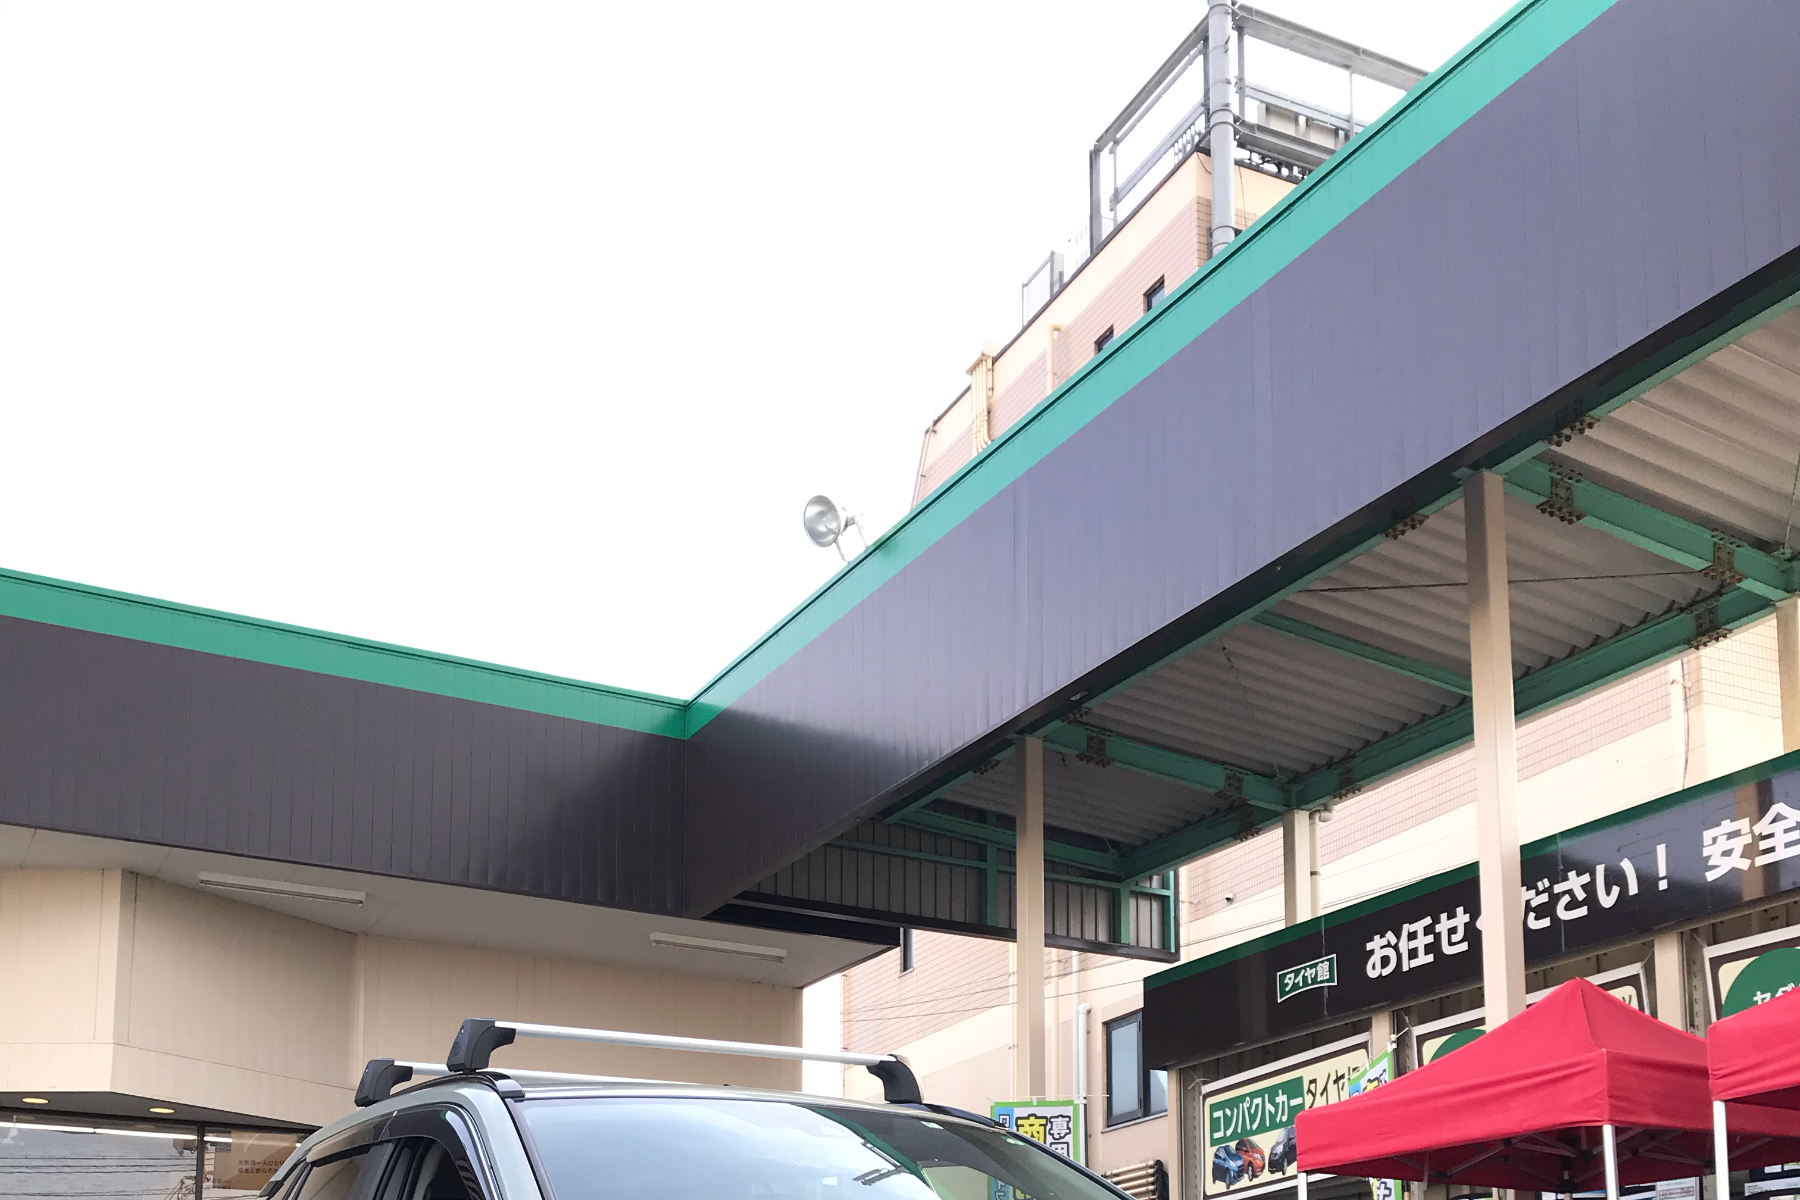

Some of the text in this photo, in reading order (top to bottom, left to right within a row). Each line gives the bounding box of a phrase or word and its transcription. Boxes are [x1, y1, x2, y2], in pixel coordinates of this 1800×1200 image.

[1366, 802, 1800, 979] お任せださい！ 安全
[1284, 961, 1330, 992] タイヤ館
[1212, 1089, 1304, 1140] コンパクトカー
